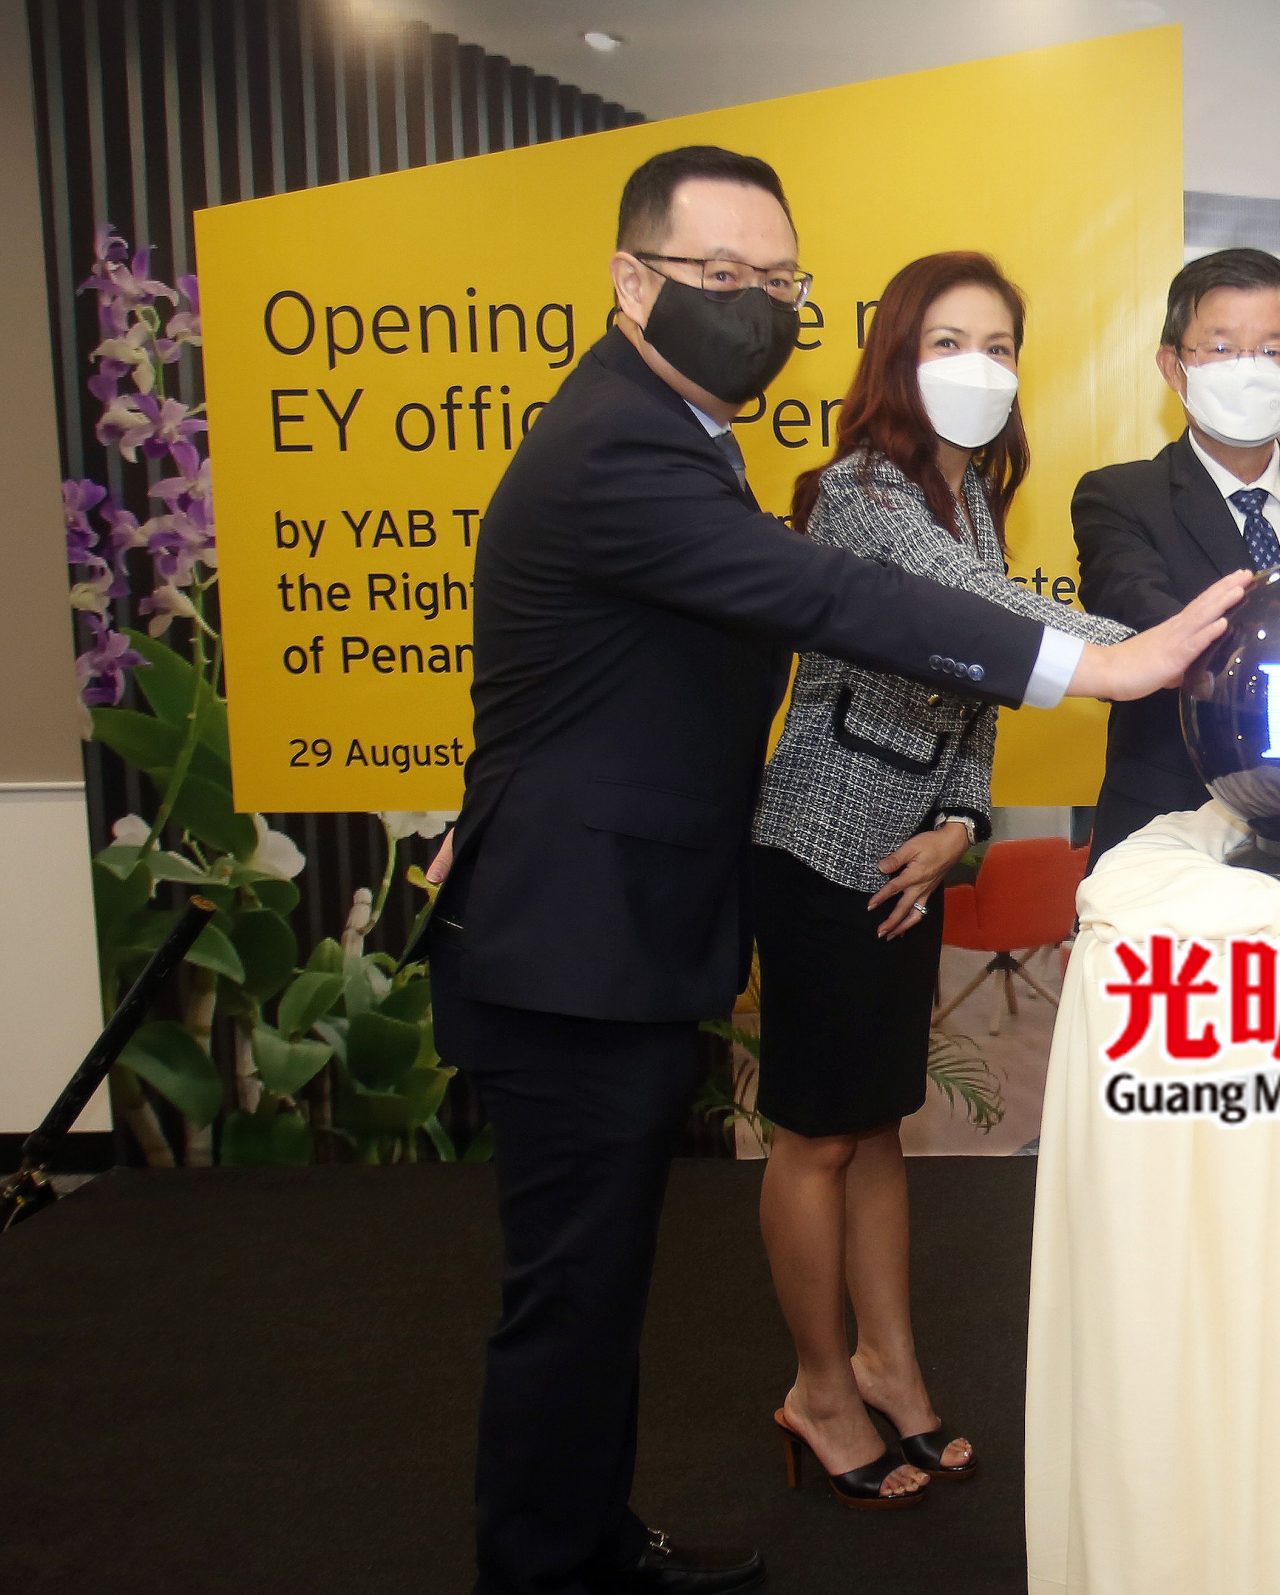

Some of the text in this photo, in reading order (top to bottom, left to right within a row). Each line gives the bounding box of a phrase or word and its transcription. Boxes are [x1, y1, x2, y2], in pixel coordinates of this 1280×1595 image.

[264, 287, 575, 371] Opening
[271, 388, 365, 452] EY
[274, 509, 484, 558] by YAB T
[278, 571, 474, 620] the Righ
[283, 635, 474, 674] of Penan
[289, 737, 465, 774] 29 August
